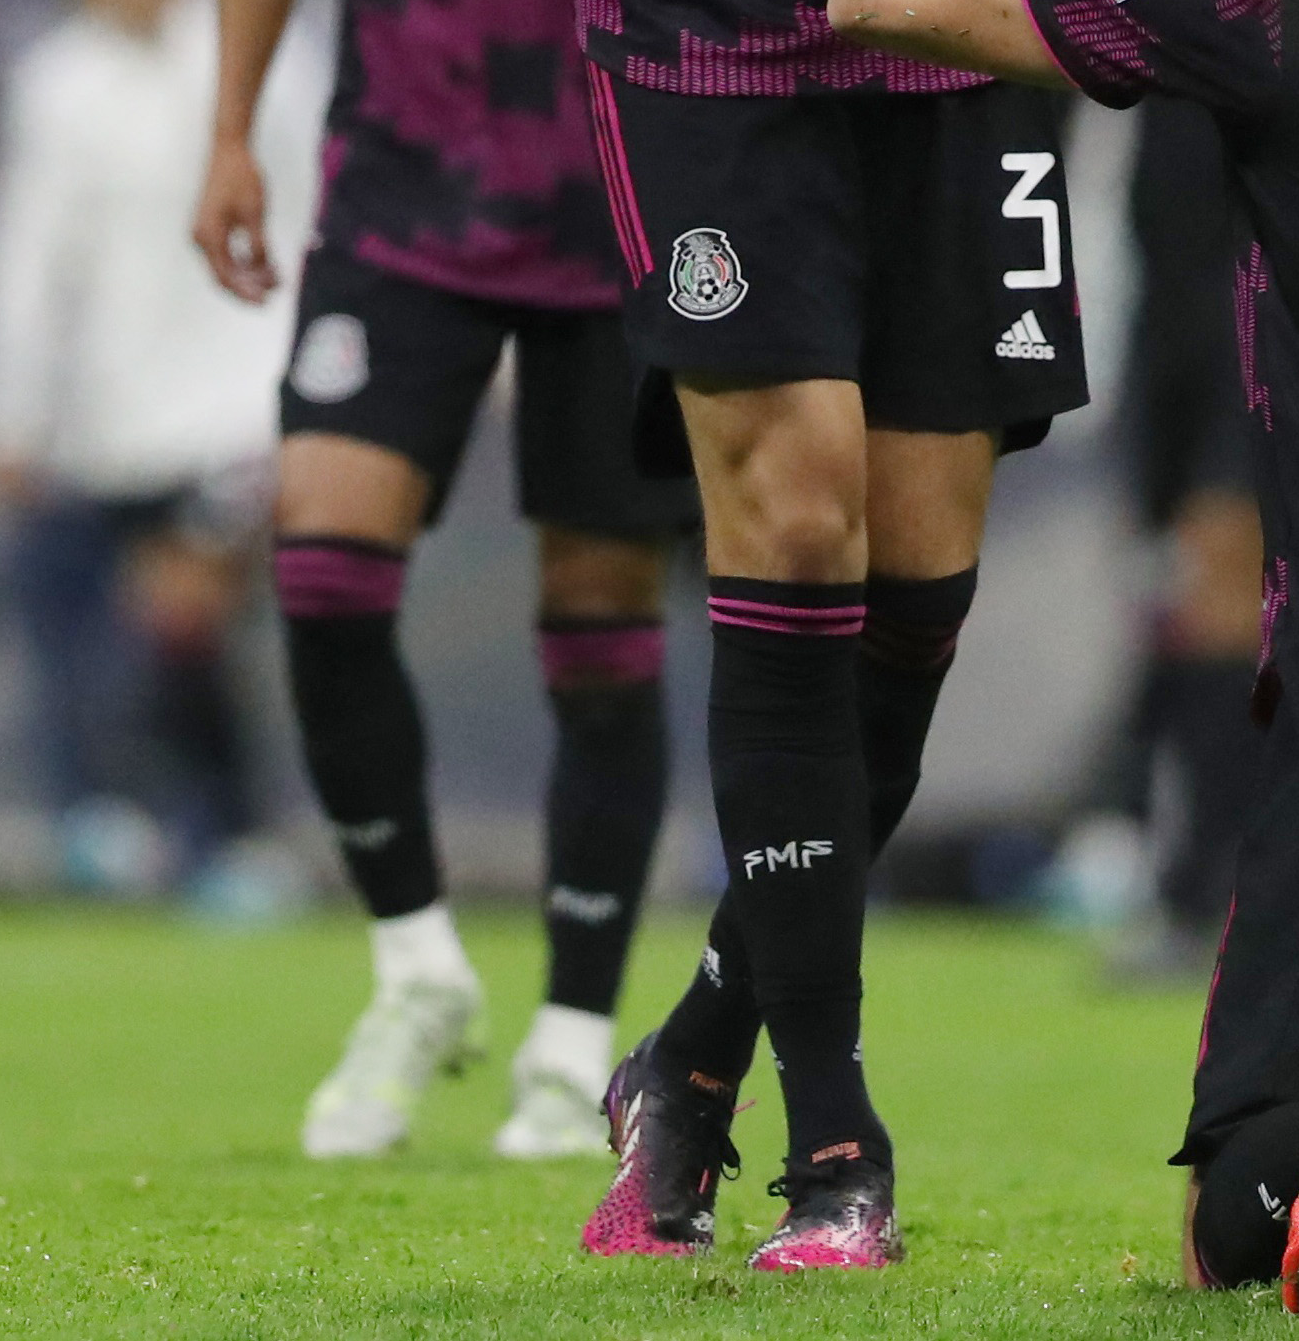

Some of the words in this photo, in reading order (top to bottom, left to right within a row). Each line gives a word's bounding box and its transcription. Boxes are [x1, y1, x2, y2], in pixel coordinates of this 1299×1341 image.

[1001, 152, 1062, 289] 3
[995, 340, 1055, 360] adidas
[743, 840, 833, 880] FMF
